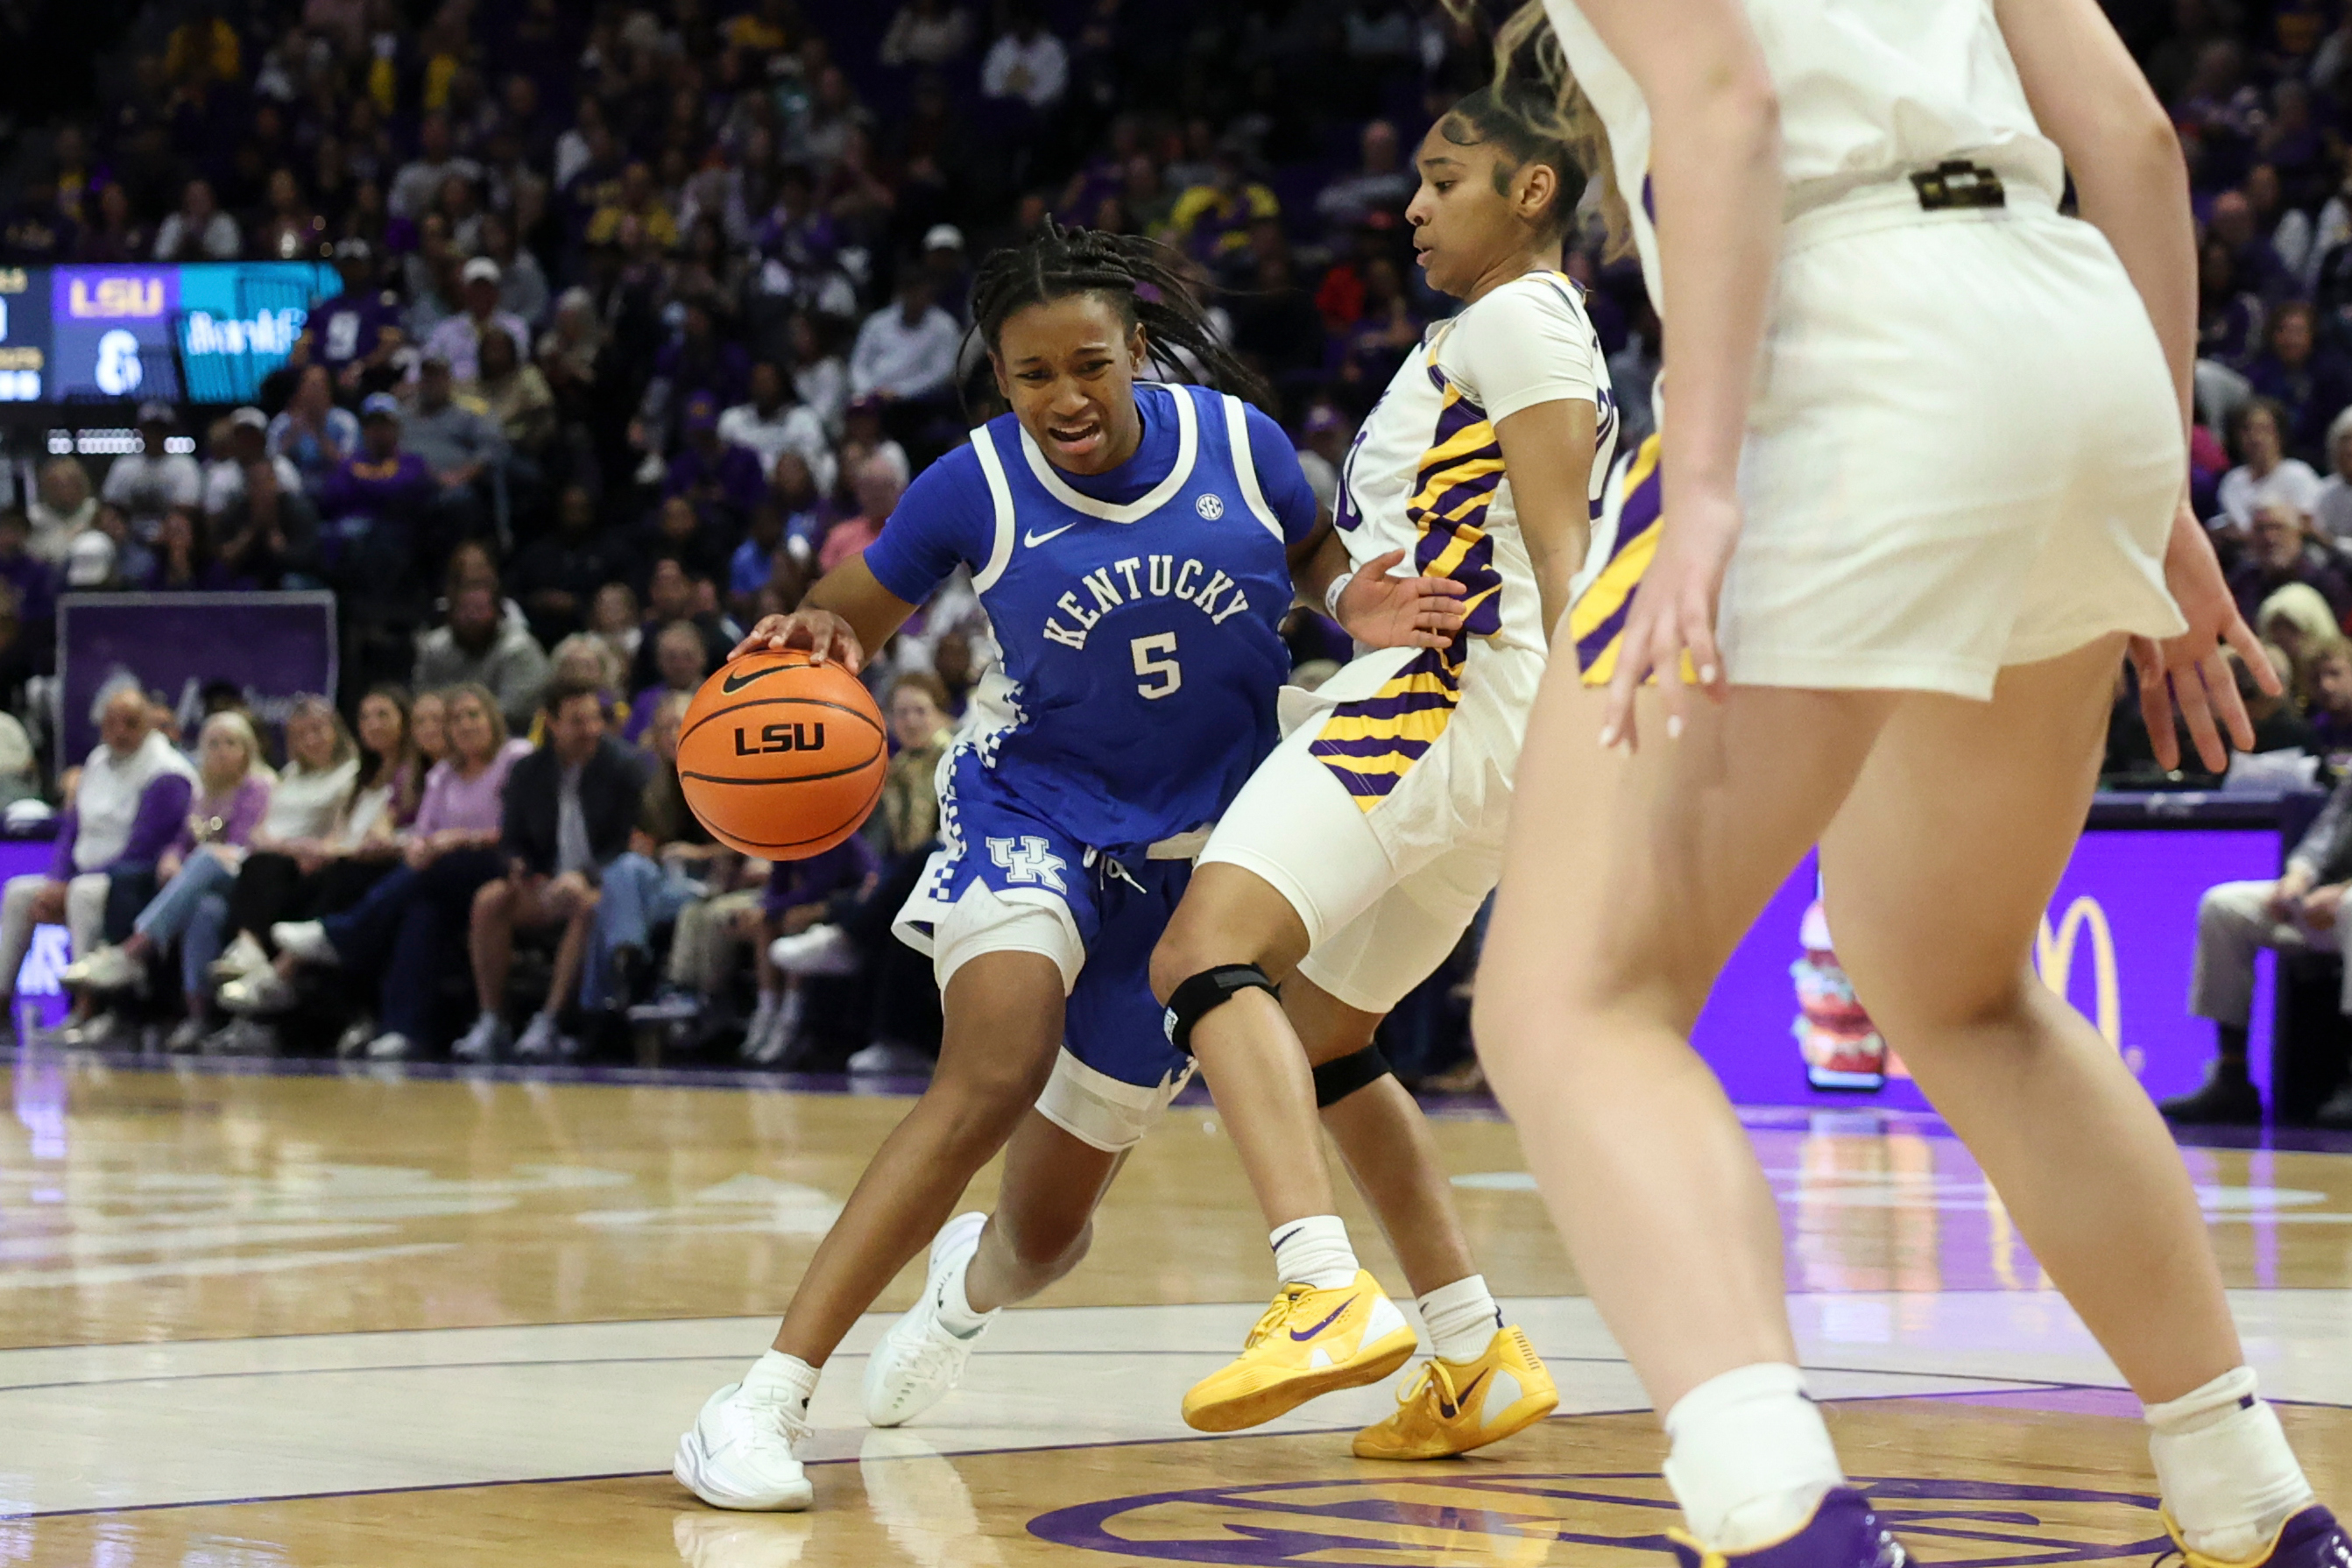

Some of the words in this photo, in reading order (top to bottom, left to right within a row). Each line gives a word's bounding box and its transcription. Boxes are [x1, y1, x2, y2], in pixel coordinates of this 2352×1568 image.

[70, 278, 165, 318] LSU
[1198, 496, 1222, 519] SEC
[1043, 554, 1249, 650] KENTUCKY
[1131, 632, 1182, 700] 5
[735, 723, 824, 756] LSU
[985, 835, 1067, 895] UK
